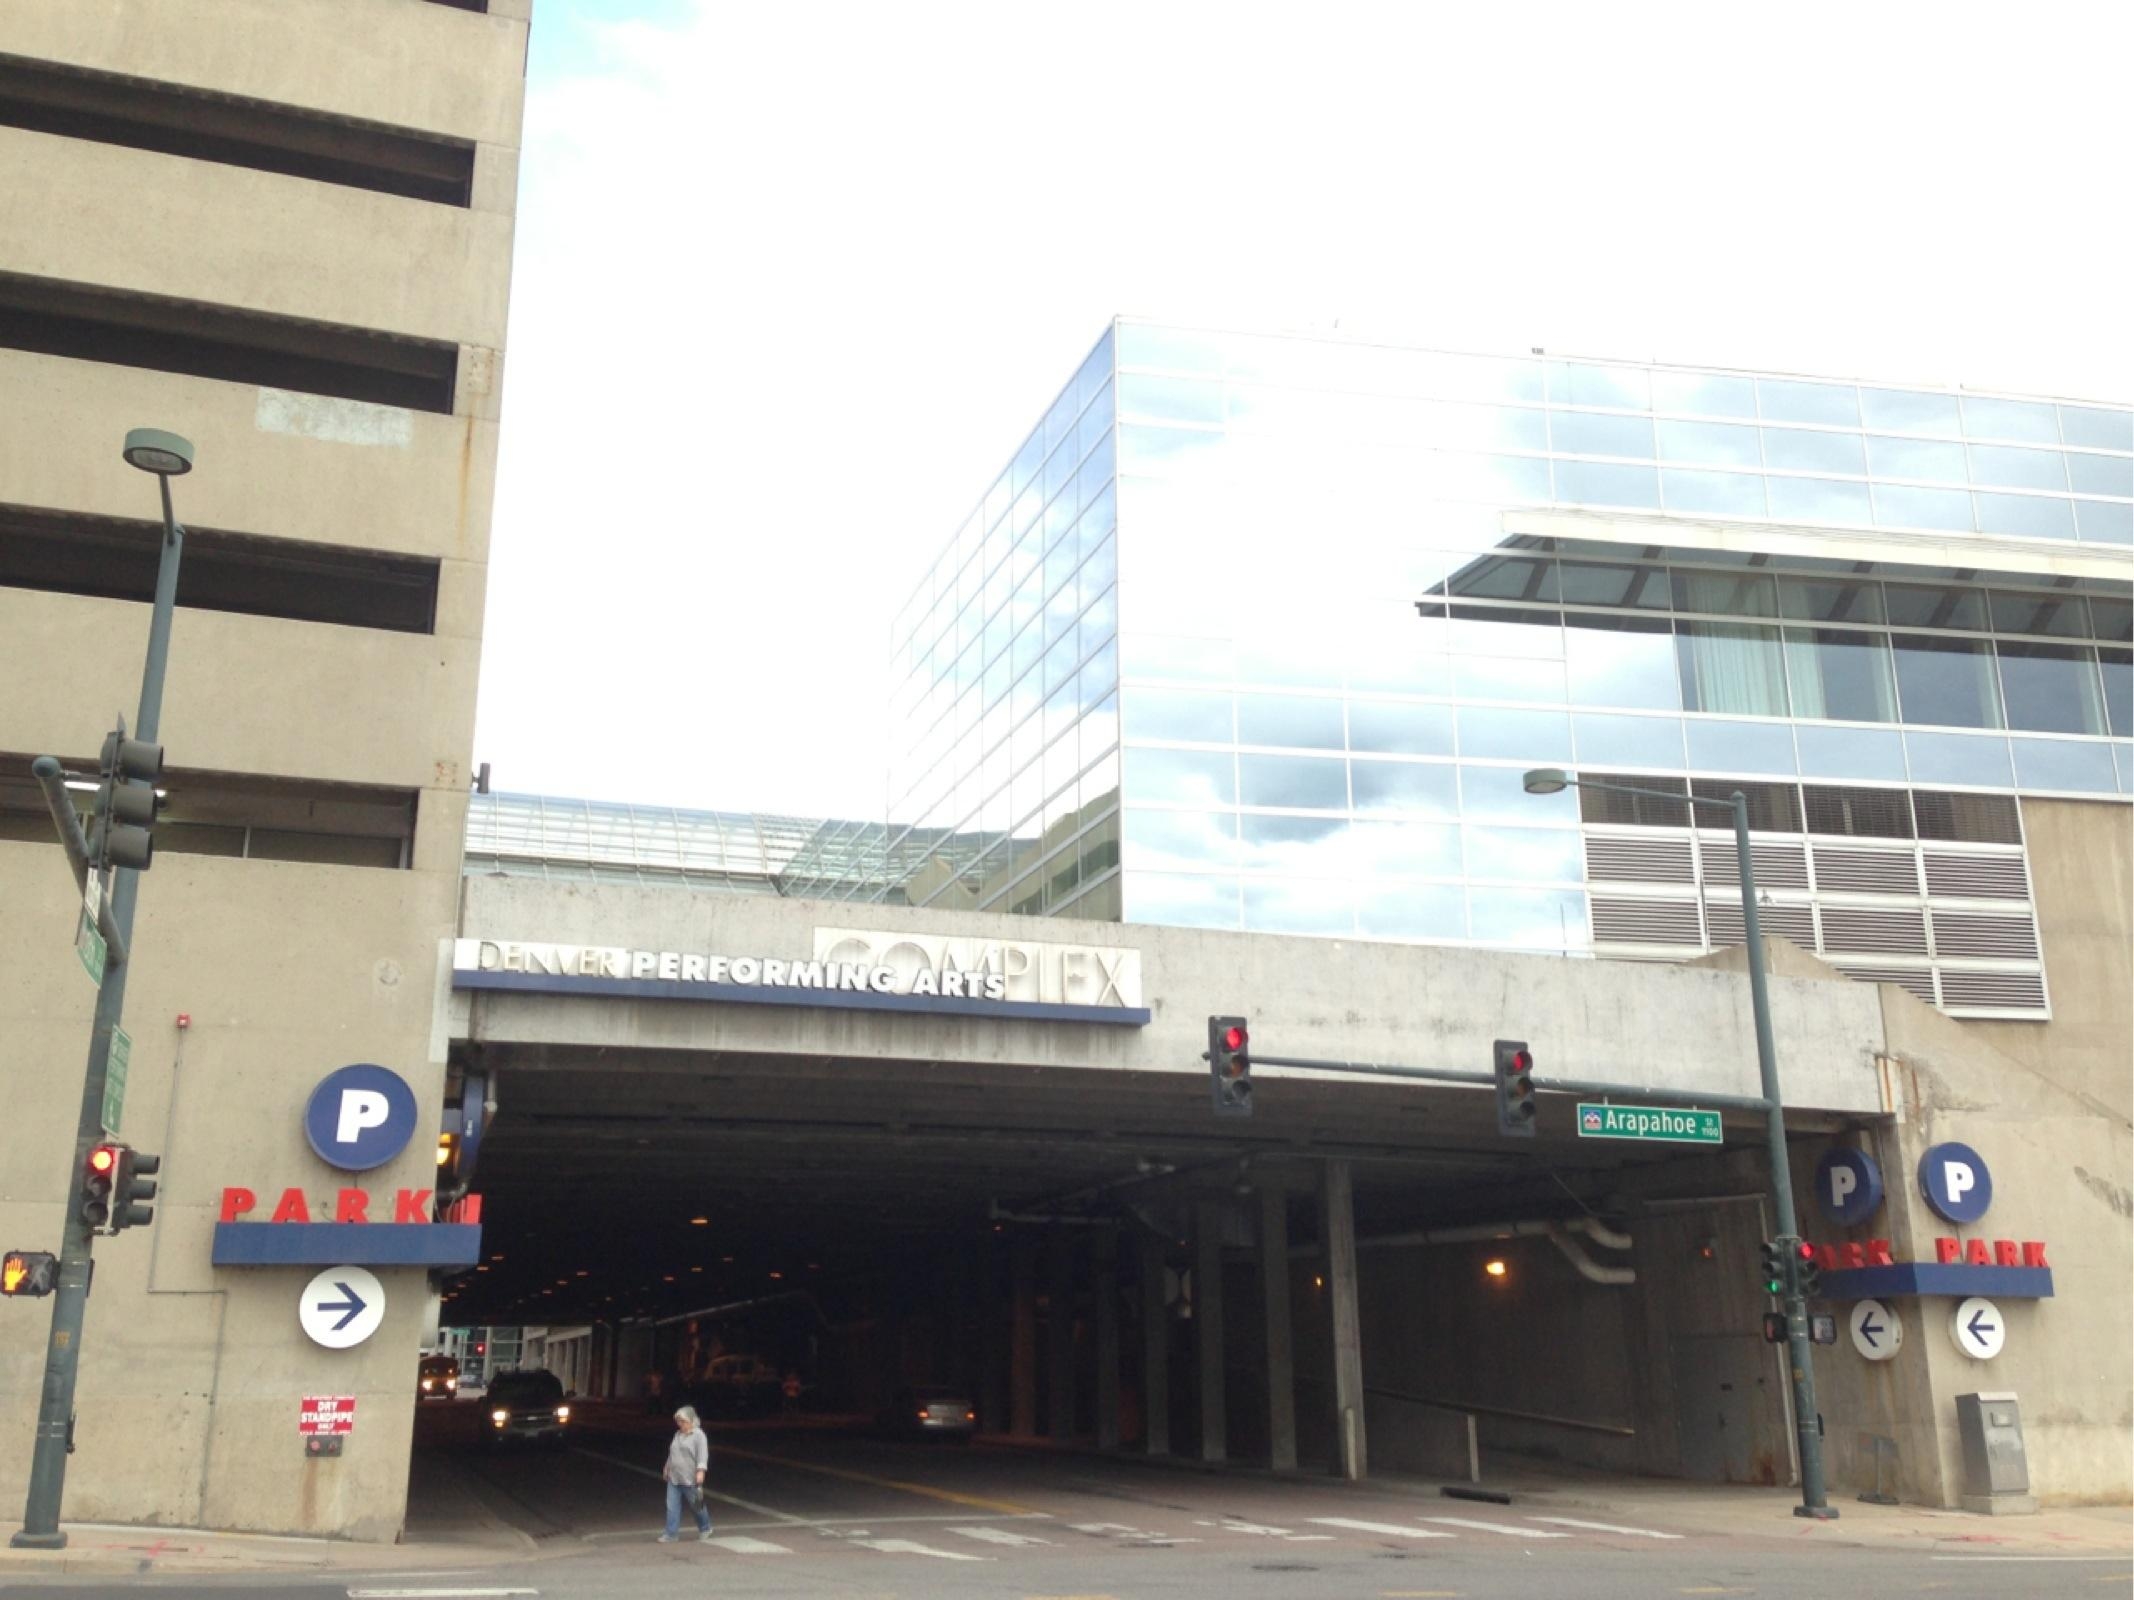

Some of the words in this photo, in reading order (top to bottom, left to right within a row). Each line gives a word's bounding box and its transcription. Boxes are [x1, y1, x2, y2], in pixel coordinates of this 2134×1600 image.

[479, 941, 616, 978] DENVER
[631, 951, 898, 993] PERFORMING
[911, 967, 1005, 999] ARTS
[336, 1089, 389, 1143] P
[1606, 1109, 1696, 1136] Arapahoe
[1830, 1166, 1857, 1207] P
[1944, 1160, 1975, 1203] P
[220, 1187, 433, 1225] PARK
[1814, 1239, 1894, 1272] ARK
[1935, 1237, 2049, 1268] PARK
[300, 1411, 353, 1424] STANDPIPE
